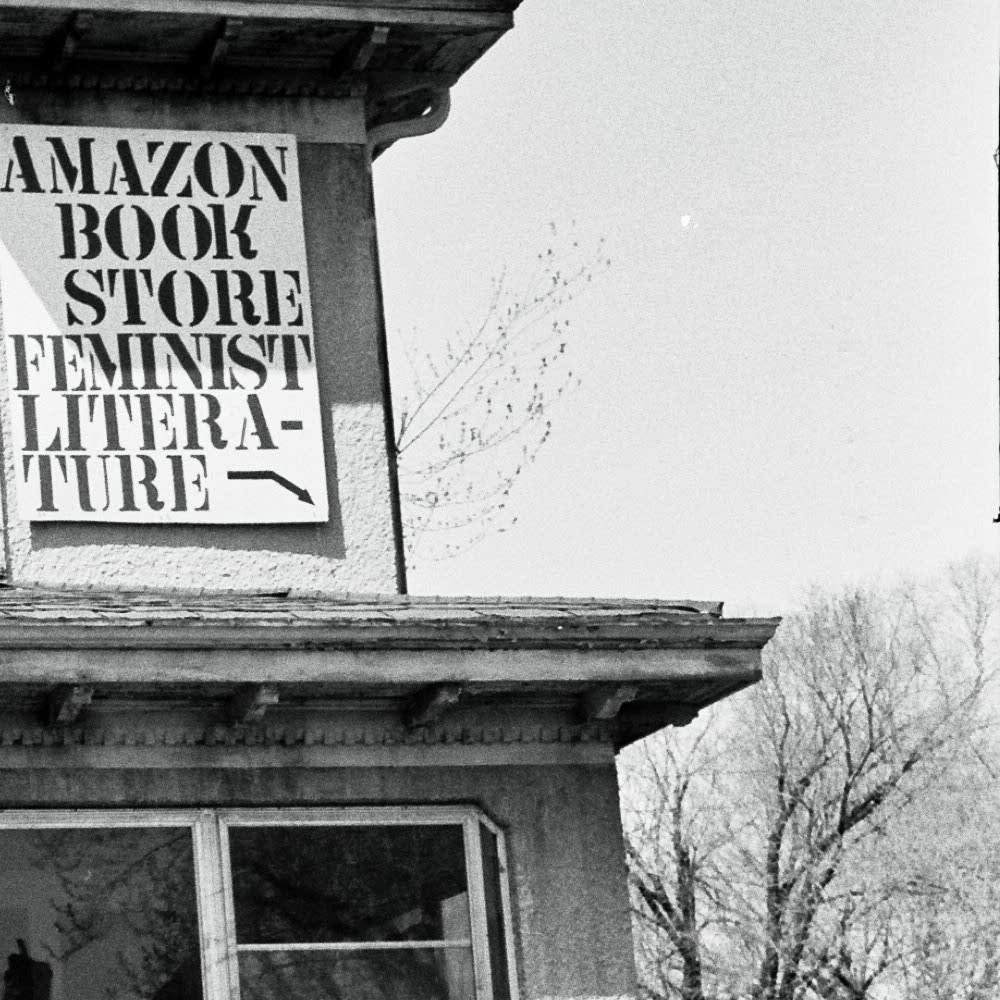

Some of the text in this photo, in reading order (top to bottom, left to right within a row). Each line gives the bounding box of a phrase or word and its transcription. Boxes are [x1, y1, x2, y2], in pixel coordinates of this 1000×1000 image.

[0, 135, 288, 202] AMAZON
[55, 203, 258, 261] BOOK
[64, 269, 302, 327] STORE
[8, 333, 312, 391] FEMINIST
[18, 394, 303, 451] LITERA-
[23, 455, 209, 511] TURE
